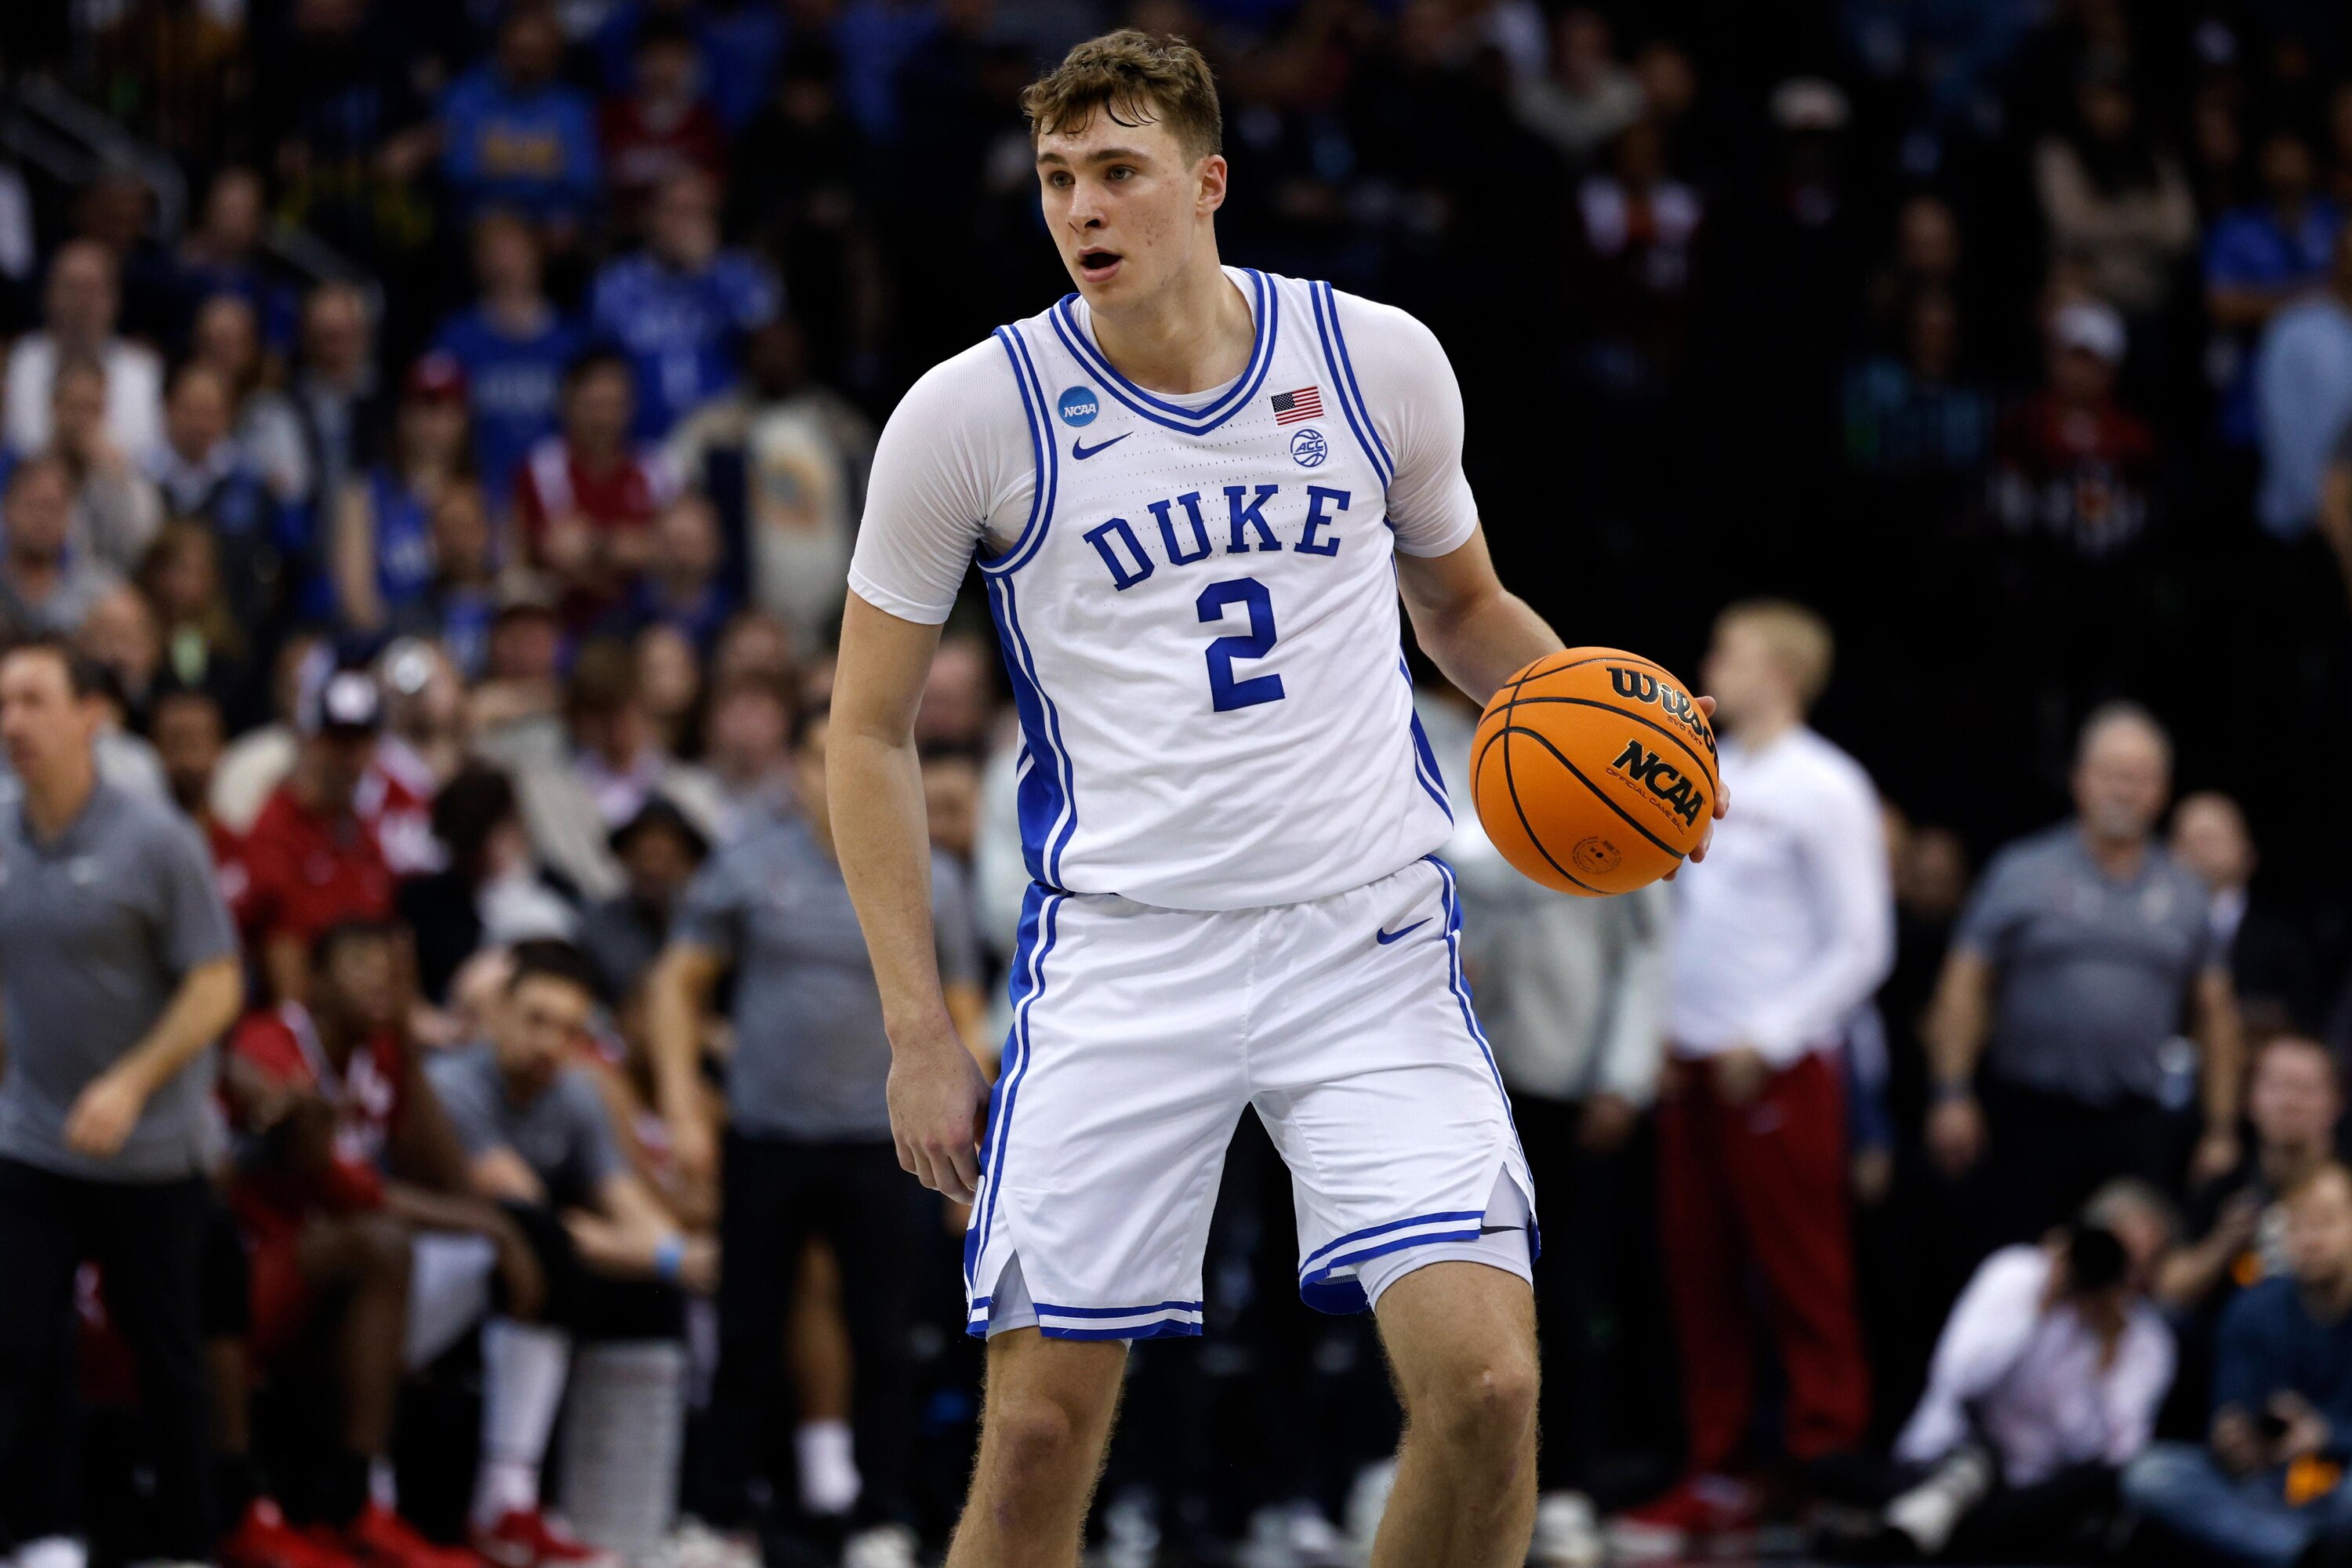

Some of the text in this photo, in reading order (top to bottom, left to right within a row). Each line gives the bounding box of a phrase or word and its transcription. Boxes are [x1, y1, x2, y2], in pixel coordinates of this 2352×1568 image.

[1064, 403, 1097, 418] NCAA
[1294, 439, 1324, 452] ACC
[1082, 484, 1351, 592] DUKE
[1196, 576, 1286, 712] 2
[1606, 666, 1719, 776] Wilso
[1667, 715, 1703, 747] EVO NXT
[1605, 768, 1647, 800] OFFICIAL
[1649, 797, 1672, 820] GAME
[1611, 738, 1704, 828] NCAA
